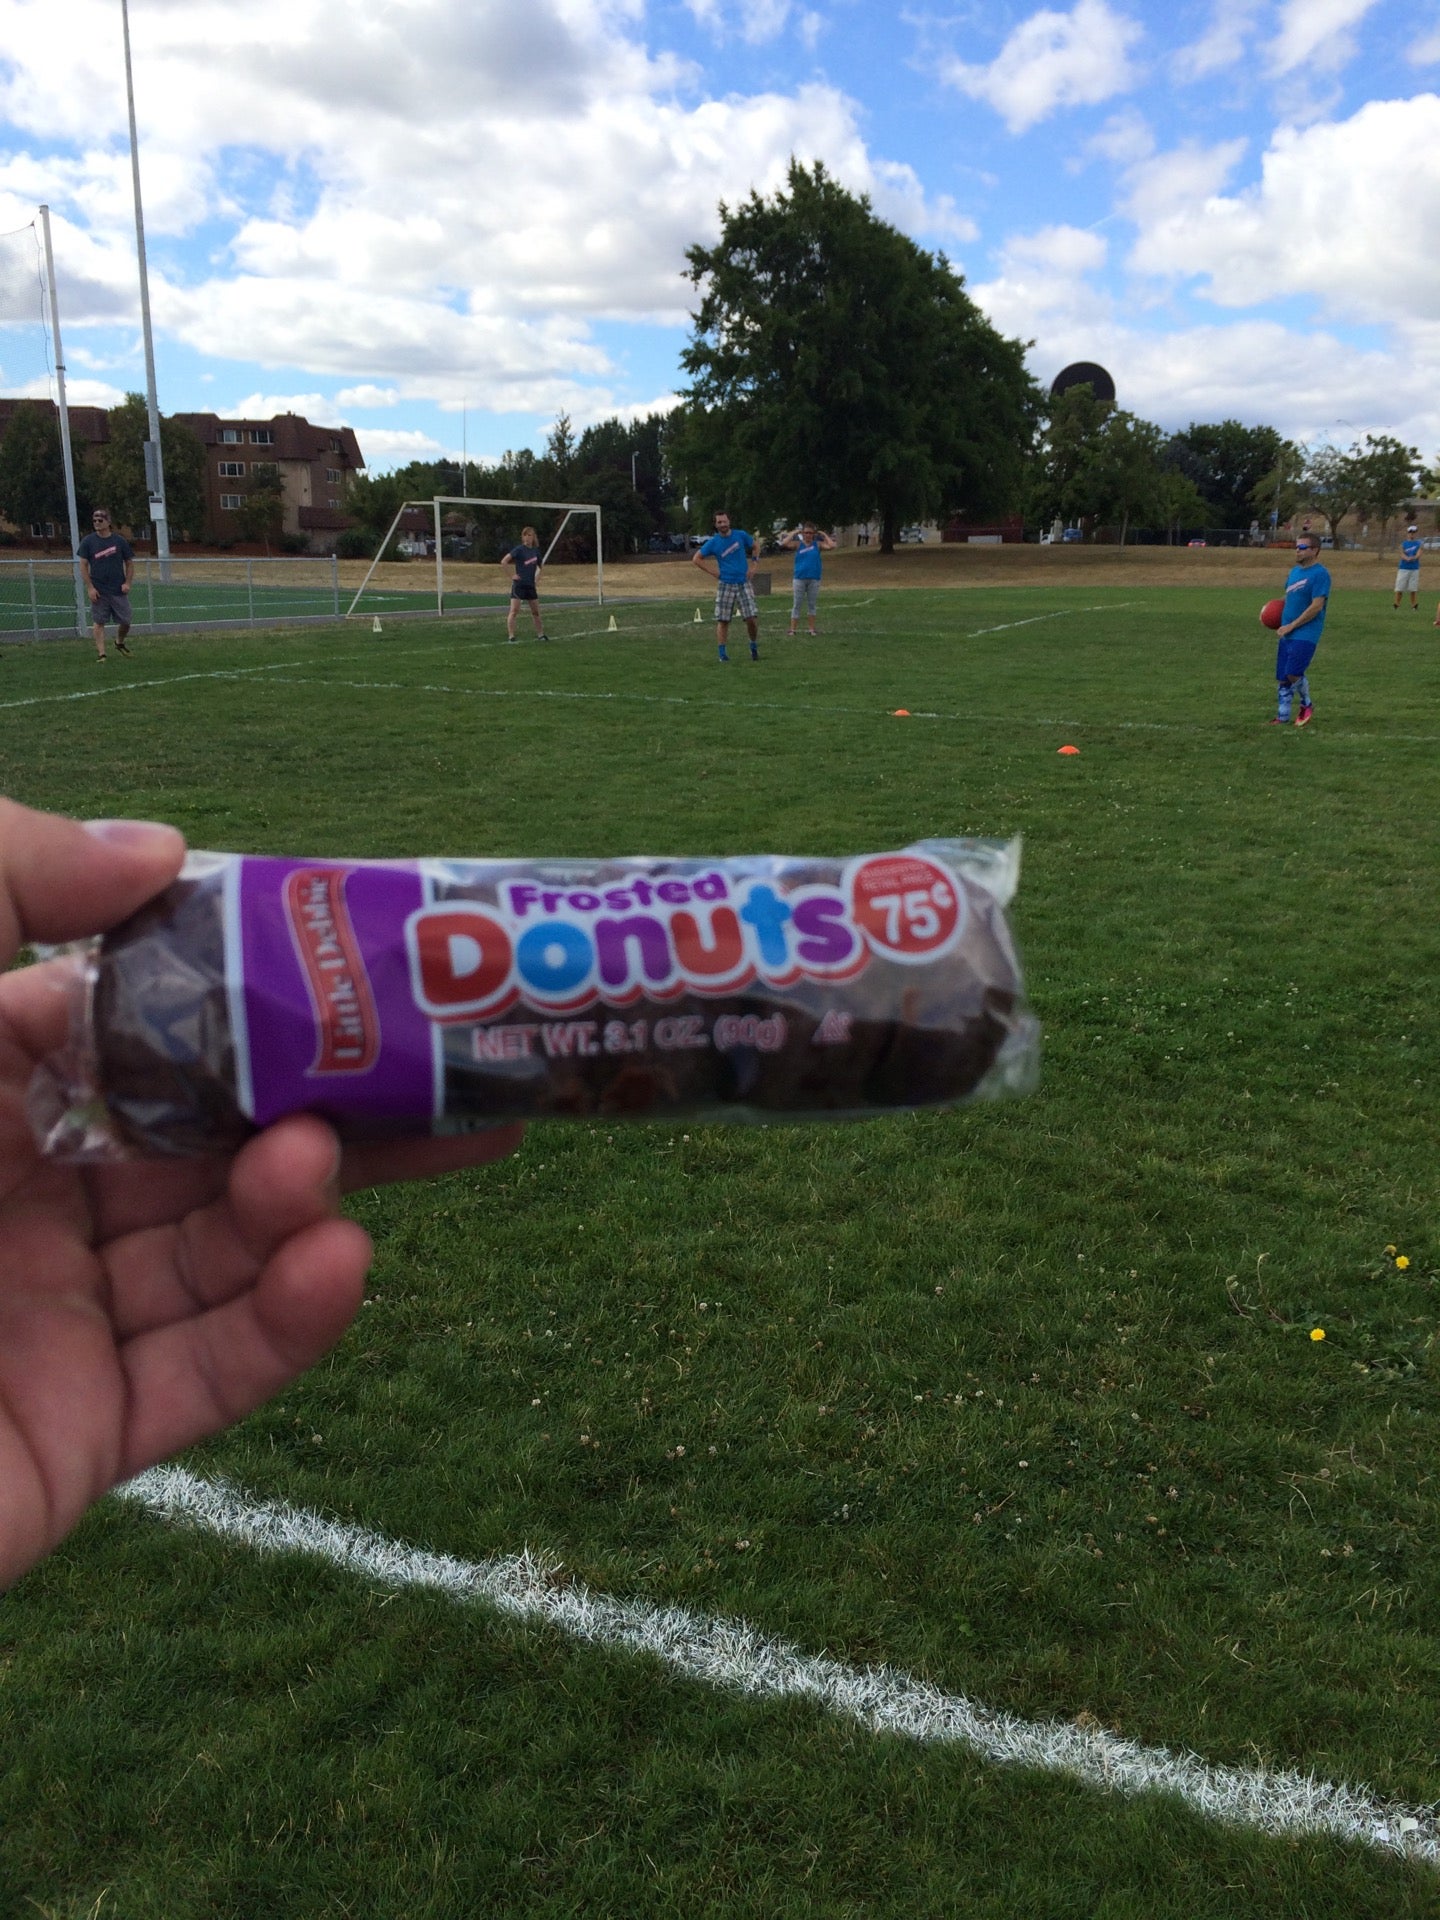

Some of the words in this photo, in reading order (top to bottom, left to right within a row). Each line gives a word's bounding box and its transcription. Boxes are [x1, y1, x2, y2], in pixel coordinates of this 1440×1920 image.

[508, 873, 728, 917] Frosted
[869, 880, 952, 944] 75¢
[414, 884, 855, 1006] Donuts
[472, 1023, 540, 1061] NET
[541, 1021, 600, 1057] WT.
[654, 1015, 710, 1049] OZ.
